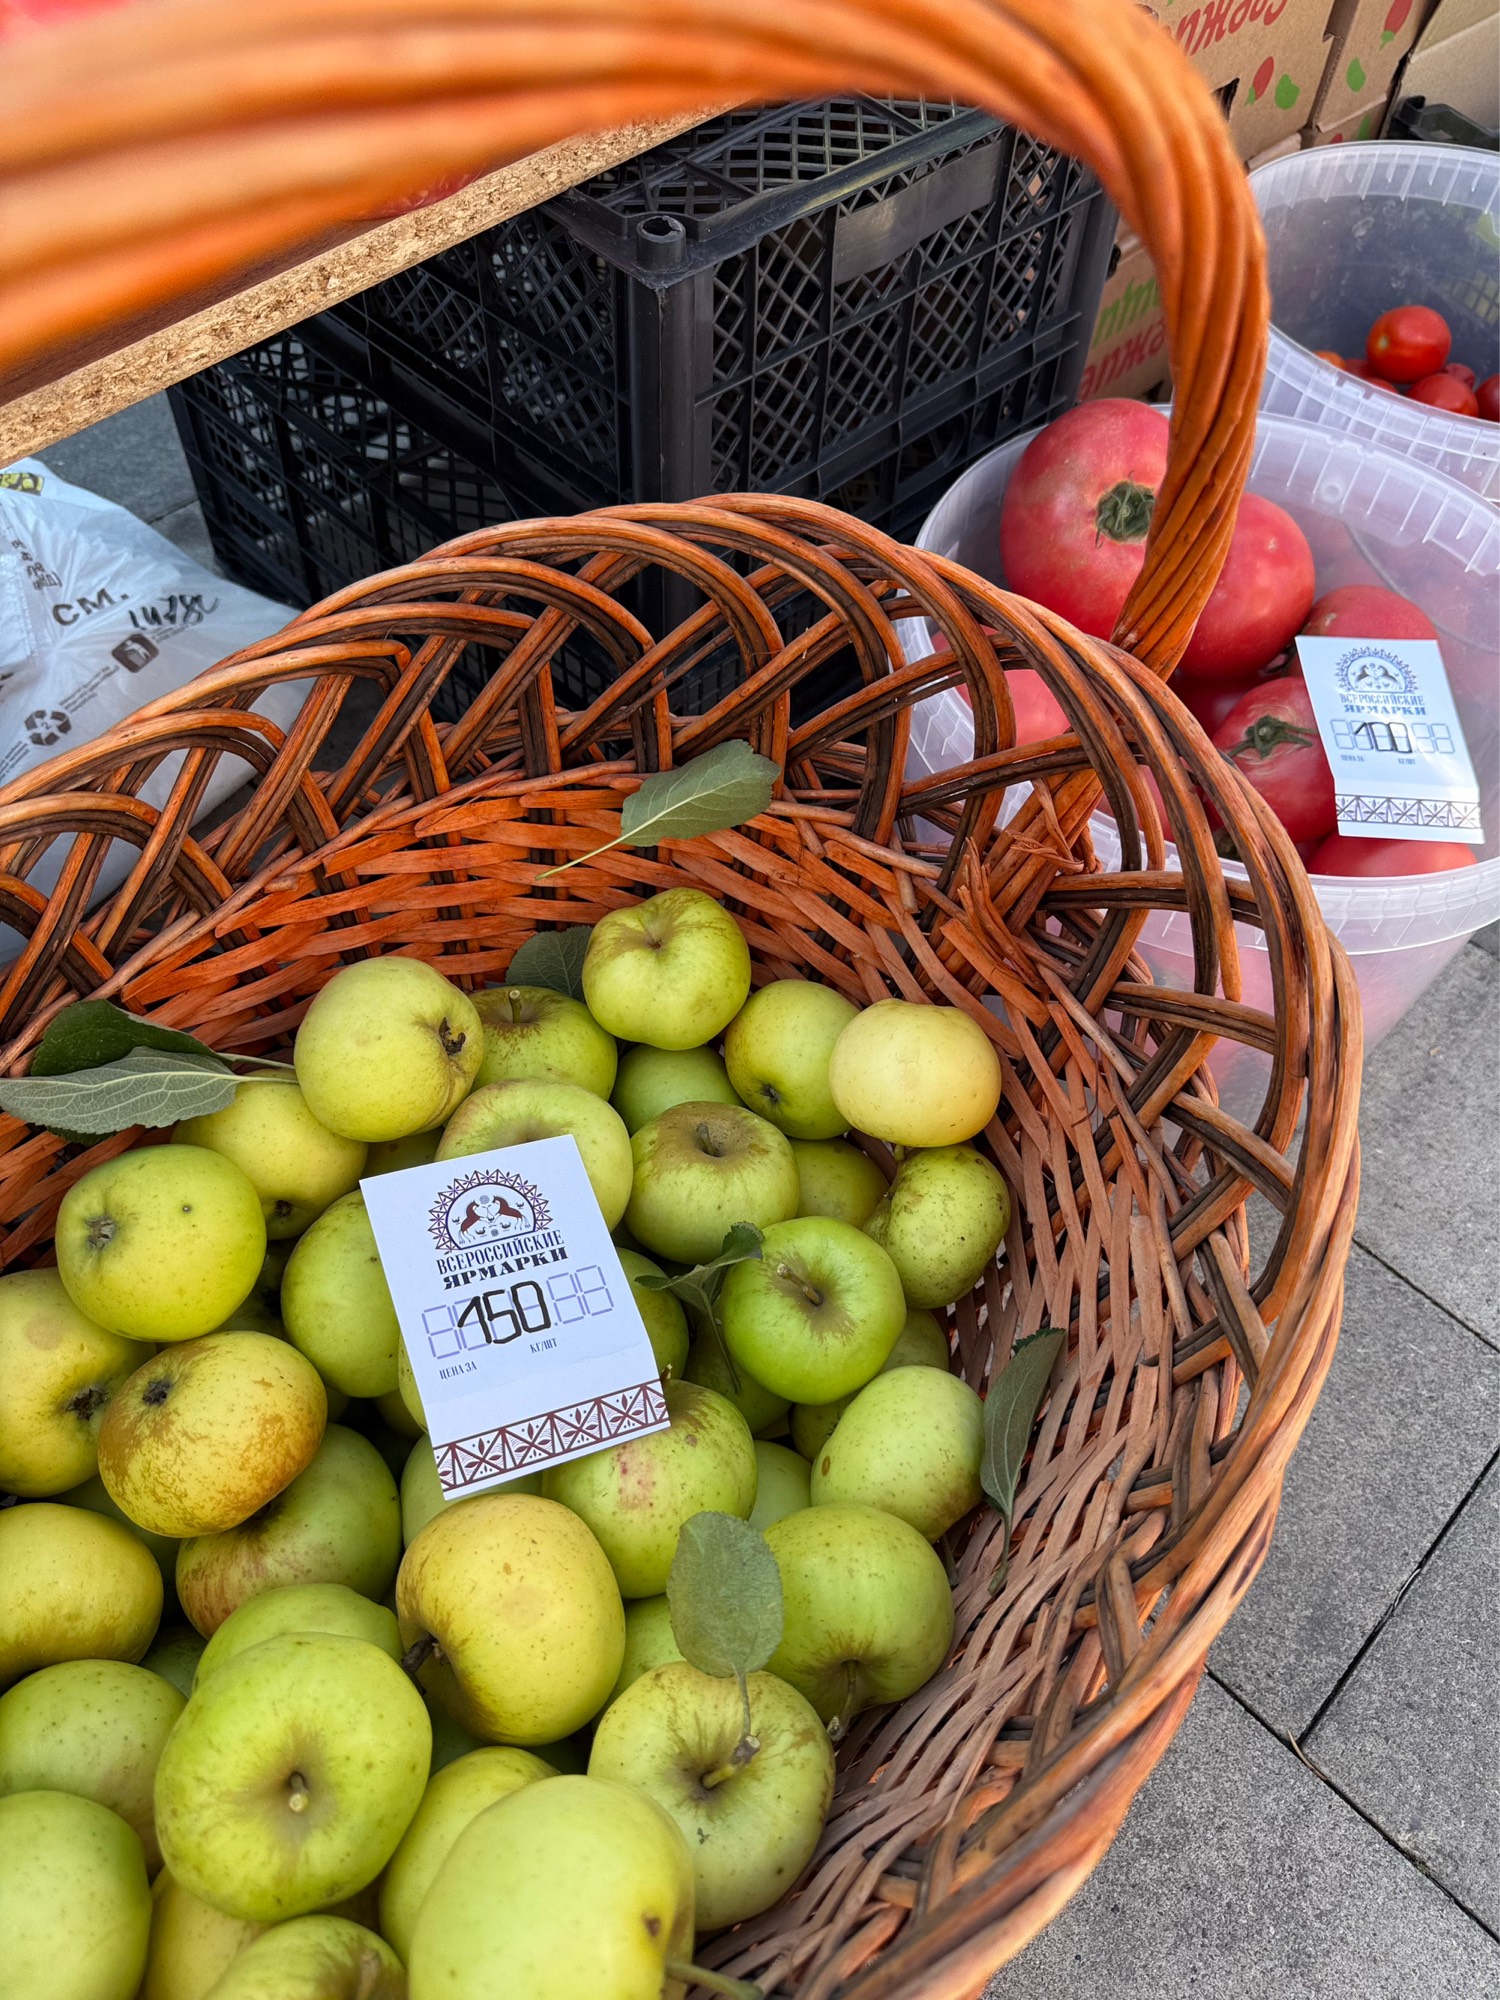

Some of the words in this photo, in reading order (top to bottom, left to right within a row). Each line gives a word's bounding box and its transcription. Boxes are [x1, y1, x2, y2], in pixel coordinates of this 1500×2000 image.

[1339, 693, 1425, 706] ВСЕРОССИЙСКИЕ
[1344, 704, 1427, 715] ЯРМАРКИ
[1353, 721, 1413, 754] 100
[436, 1229, 565, 1275] ВСЕРОССИЙСКИЕ
[443, 1246, 569, 1290] ЯРМАРКИ
[457, 1280, 552, 1344] 150
[529, 1337, 558, 1354] КГ/ШТ
[439, 1364, 465, 1380] ЦЕНА
[465, 1360, 478, 1373] ЗА
